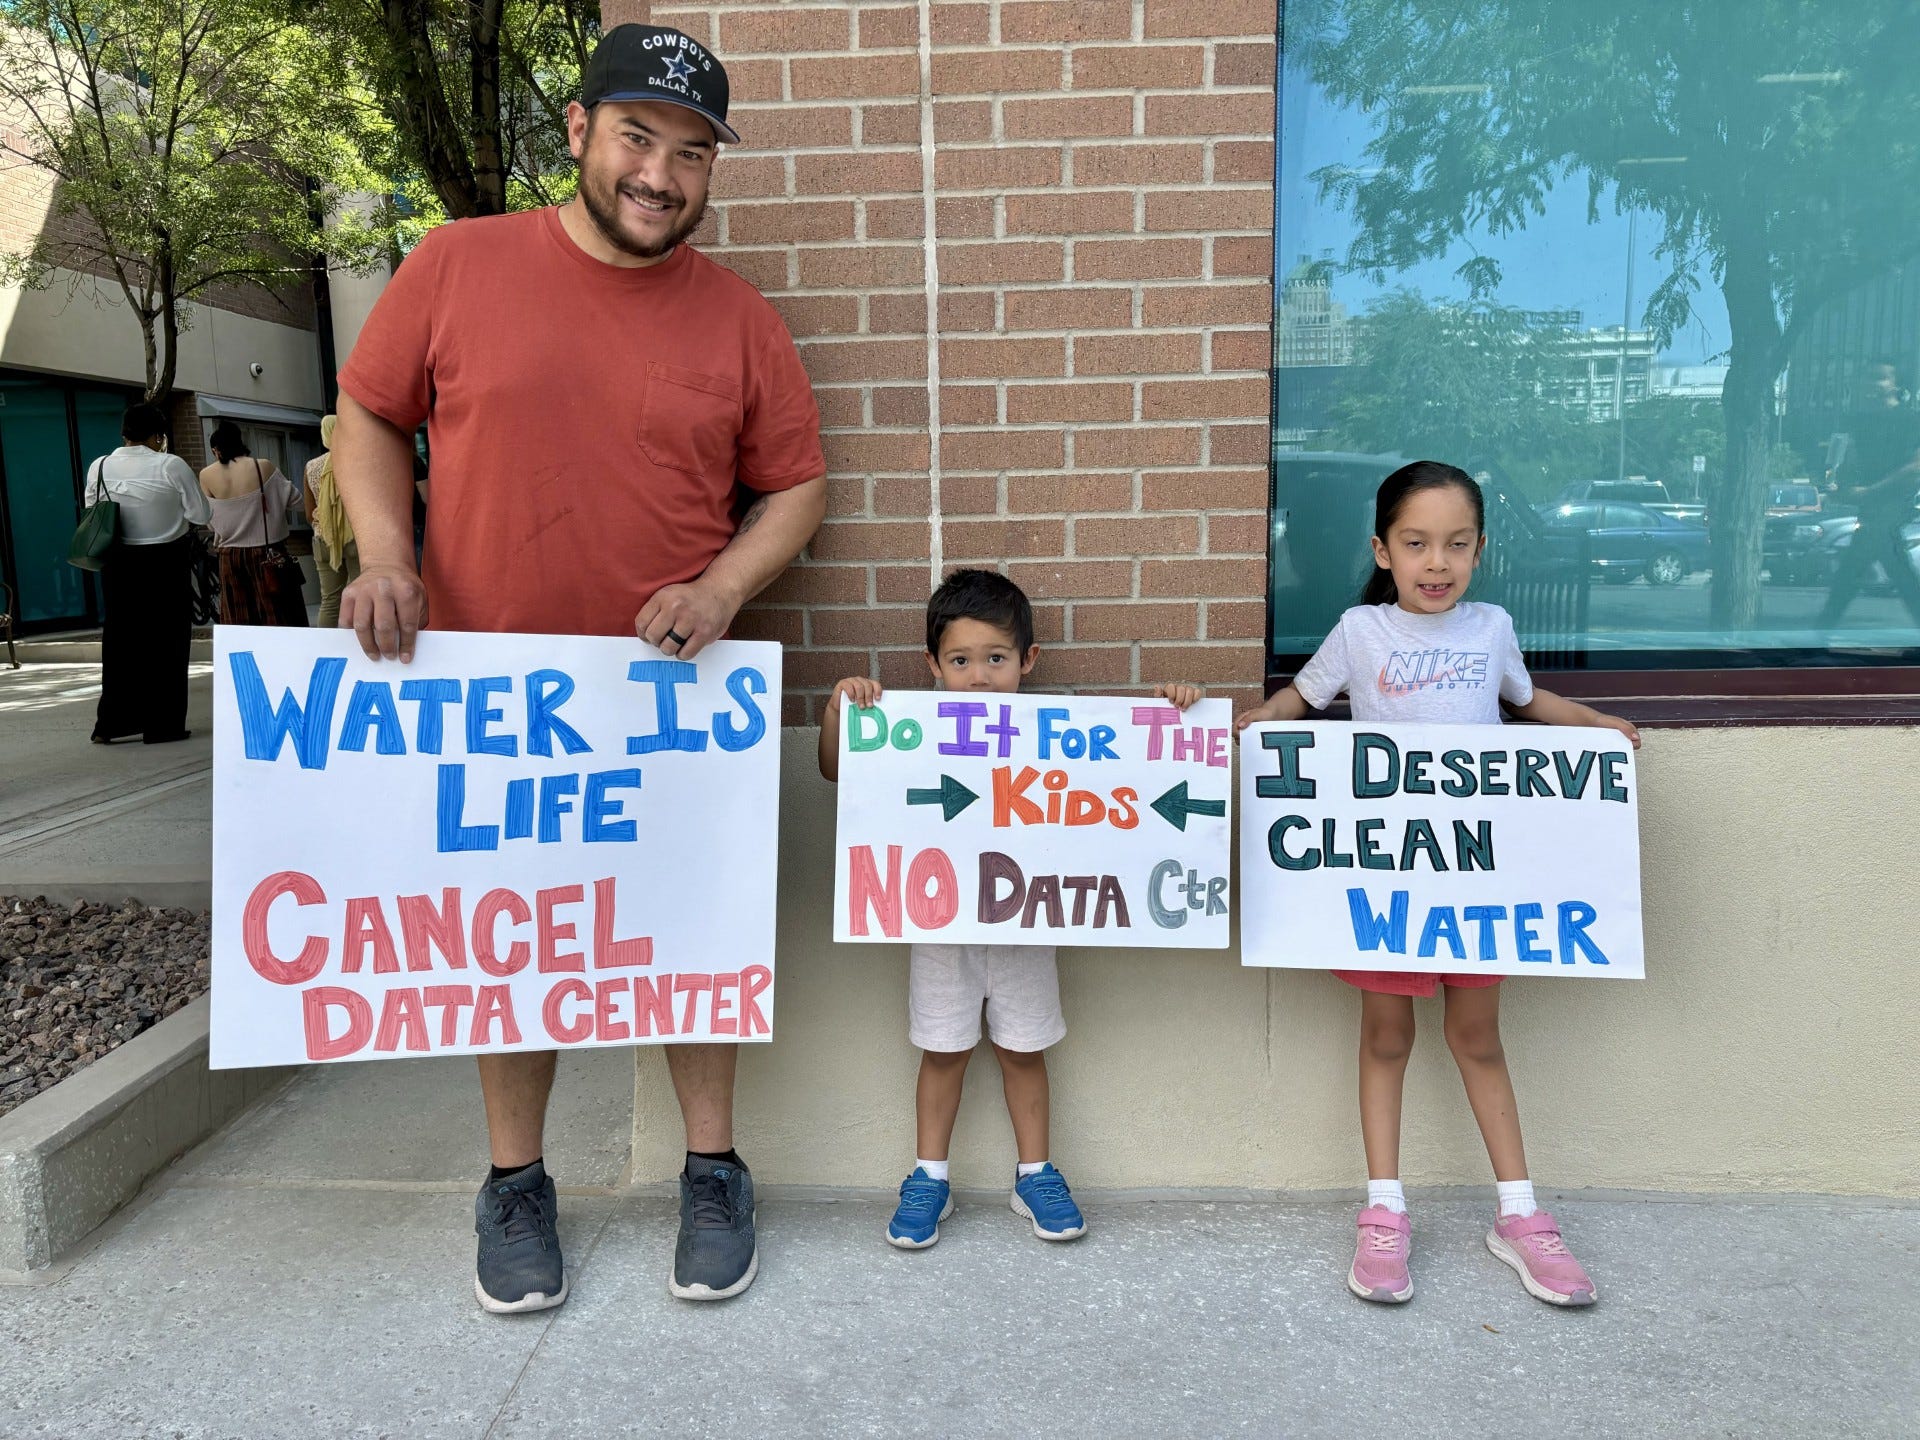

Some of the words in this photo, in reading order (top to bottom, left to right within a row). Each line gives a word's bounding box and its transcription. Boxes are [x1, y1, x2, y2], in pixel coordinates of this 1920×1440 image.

[642, 34, 711, 72] COWBOYS
[648, 76, 689, 96] DALLAS,
[692, 90, 702, 103] TX
[1384, 651, 1489, 685] NIKE
[1386, 682, 1425, 692] JUST
[1436, 682, 1456, 690] DO
[1466, 682, 1485, 690] IT.
[228, 651, 593, 771] WATER
[626, 660, 768, 756] IS
[1037, 707, 1120, 761] FOR
[1131, 706, 1229, 768] THE
[1255, 731, 1317, 799] I
[1352, 732, 1629, 803] DESERVE
[436, 763, 642, 853] LIFE
[1267, 814, 1496, 872] CLEAN
[848, 844, 959, 937] NO
[977, 851, 1131, 929] DATA
[1345, 887, 1610, 965] WATER
[242, 871, 653, 986] CANCEL
[302, 983, 524, 1061] DATA
[541, 964, 773, 1044] CENTER
